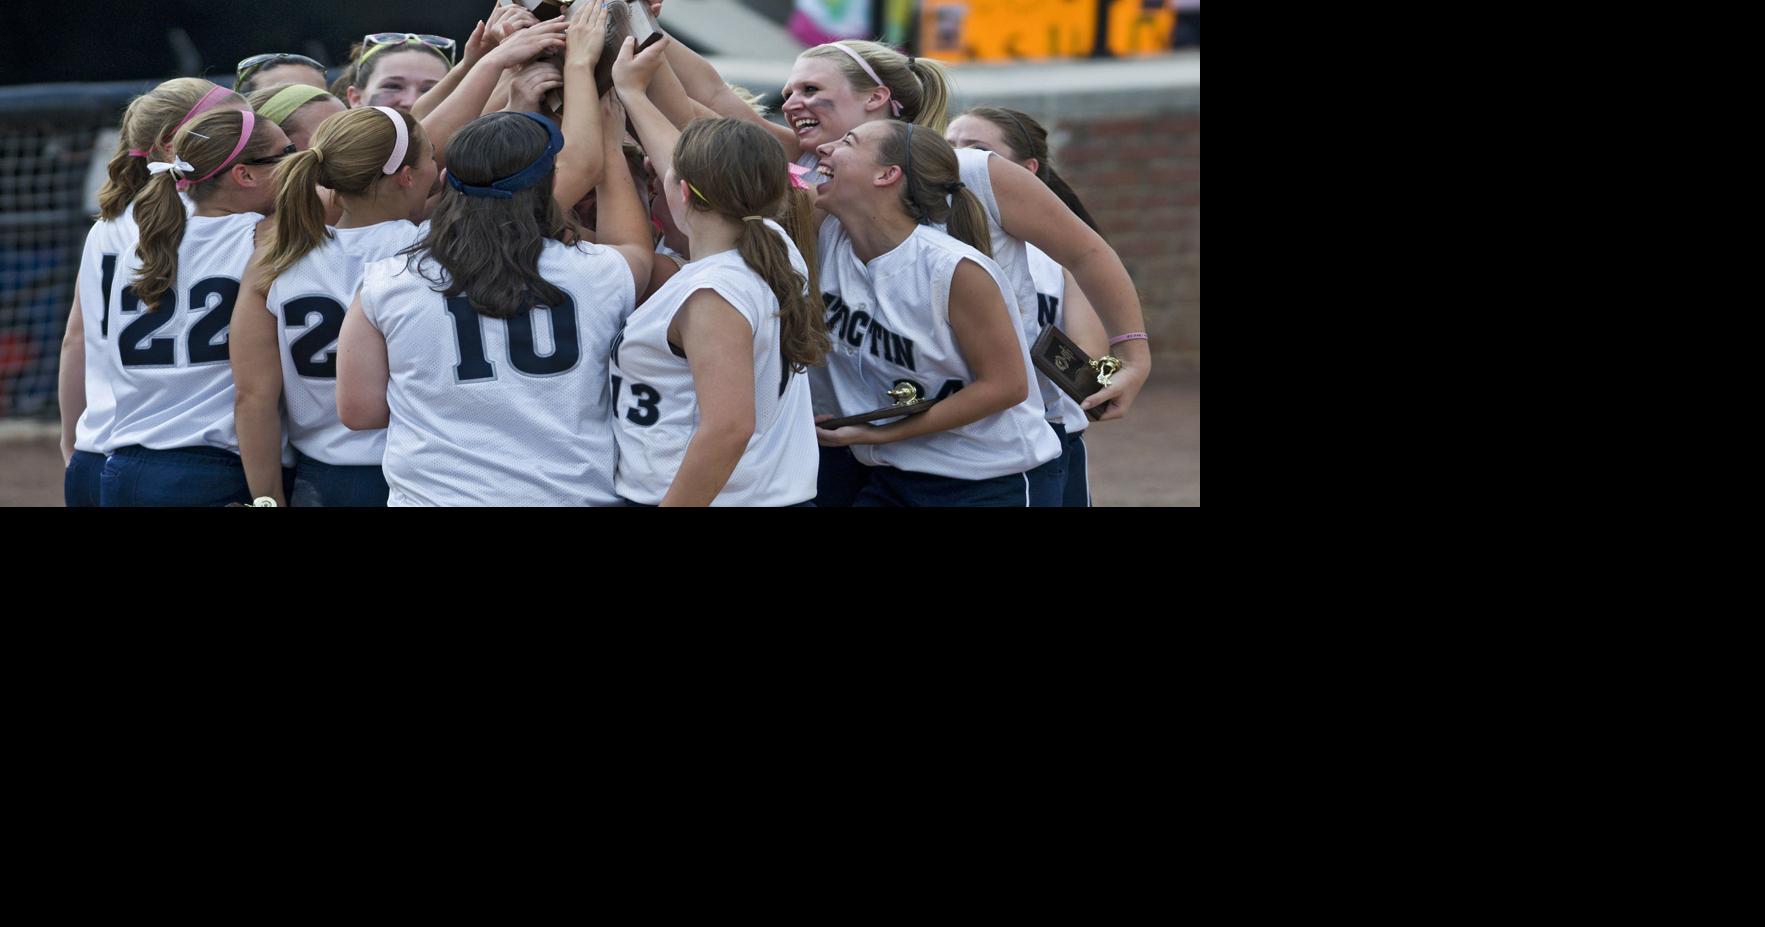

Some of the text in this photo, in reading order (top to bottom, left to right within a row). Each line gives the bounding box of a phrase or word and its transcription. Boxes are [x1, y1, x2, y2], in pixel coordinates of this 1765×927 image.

[118, 275, 241, 368] 22
[443, 286, 584, 385] 10
[611, 374, 661, 428] 13
